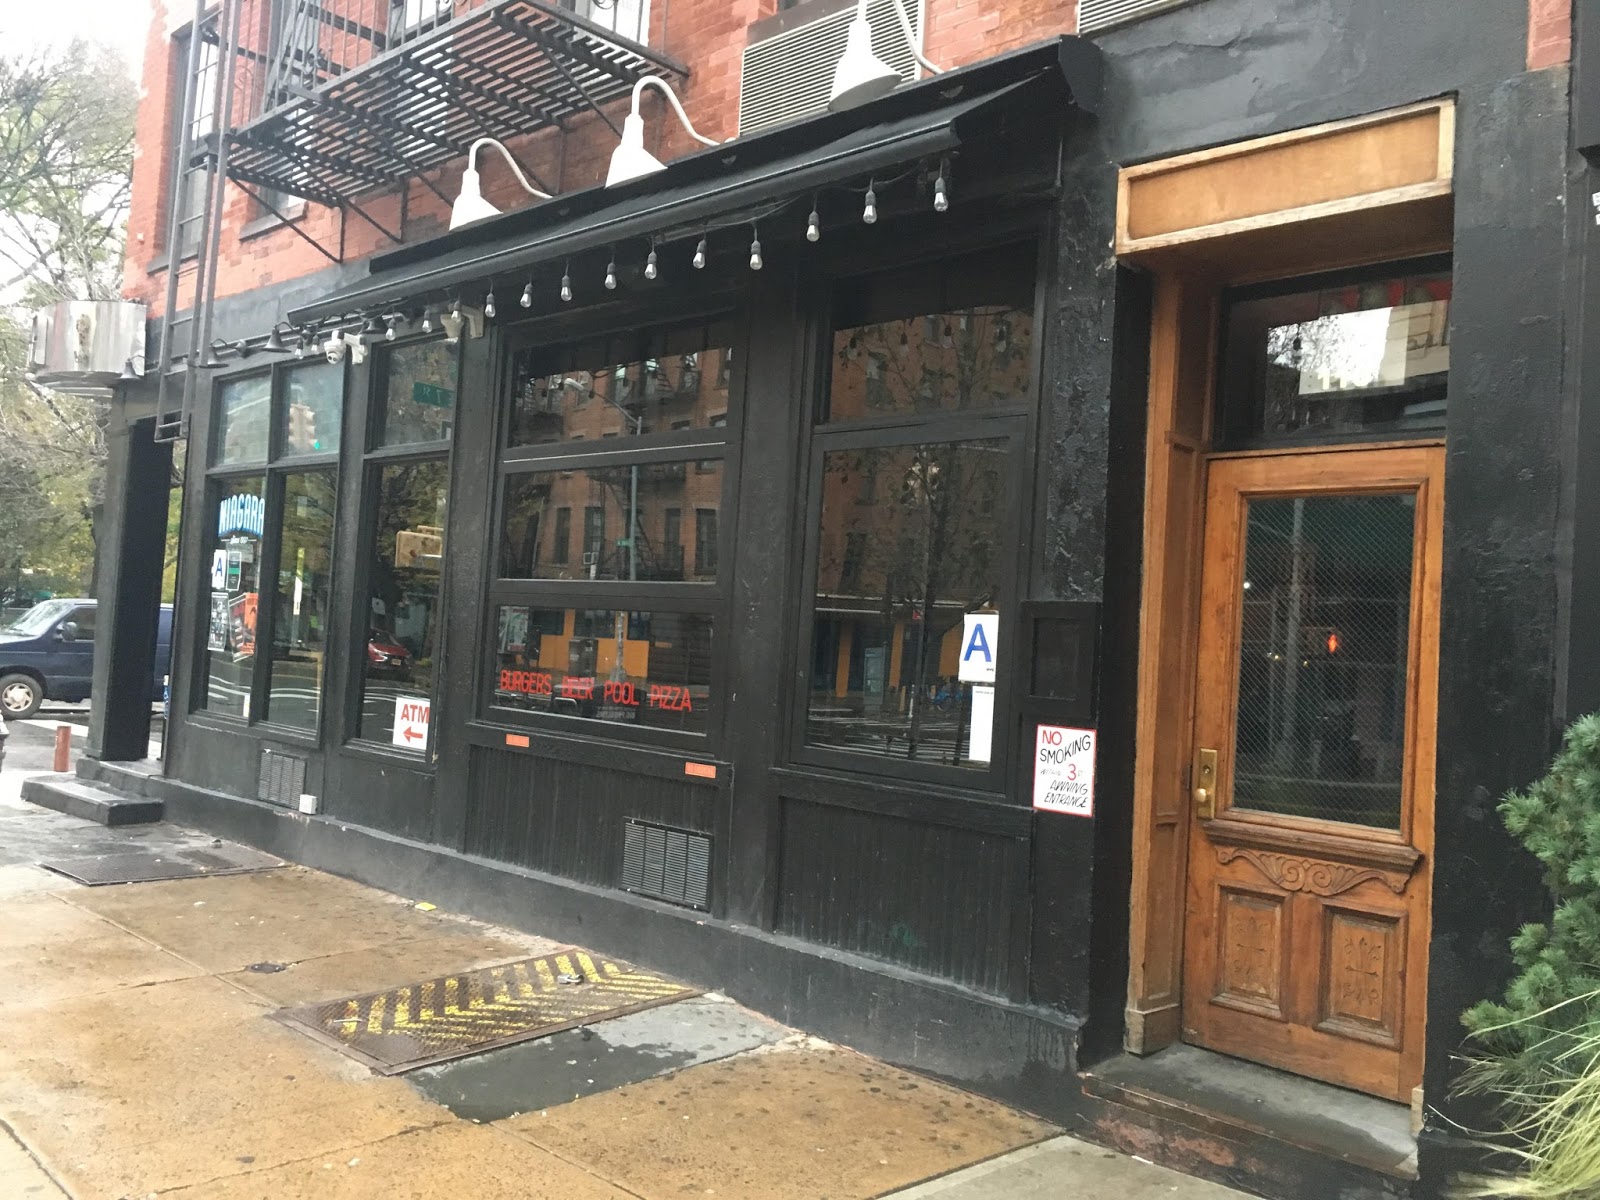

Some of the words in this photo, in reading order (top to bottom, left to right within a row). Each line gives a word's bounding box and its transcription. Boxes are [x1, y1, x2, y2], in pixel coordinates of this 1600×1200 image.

[218, 493, 266, 536] NIAGARA
[215, 557, 223, 577] A
[963, 623, 992, 662] A
[500, 669, 552, 696] BURGERS
[561, 675, 595, 700] BEER
[603, 680, 640, 706] POOL
[649, 684, 692, 712] PIZZA
[401, 703, 430, 724] ATM
[1042, 730, 1063, 746] NO
[1039, 734, 1091, 765] SMOKING
[1067, 763, 1077, 781] 3
[1049, 779, 1088, 796] AWNING
[1044, 791, 1089, 808] ENTRANCE
